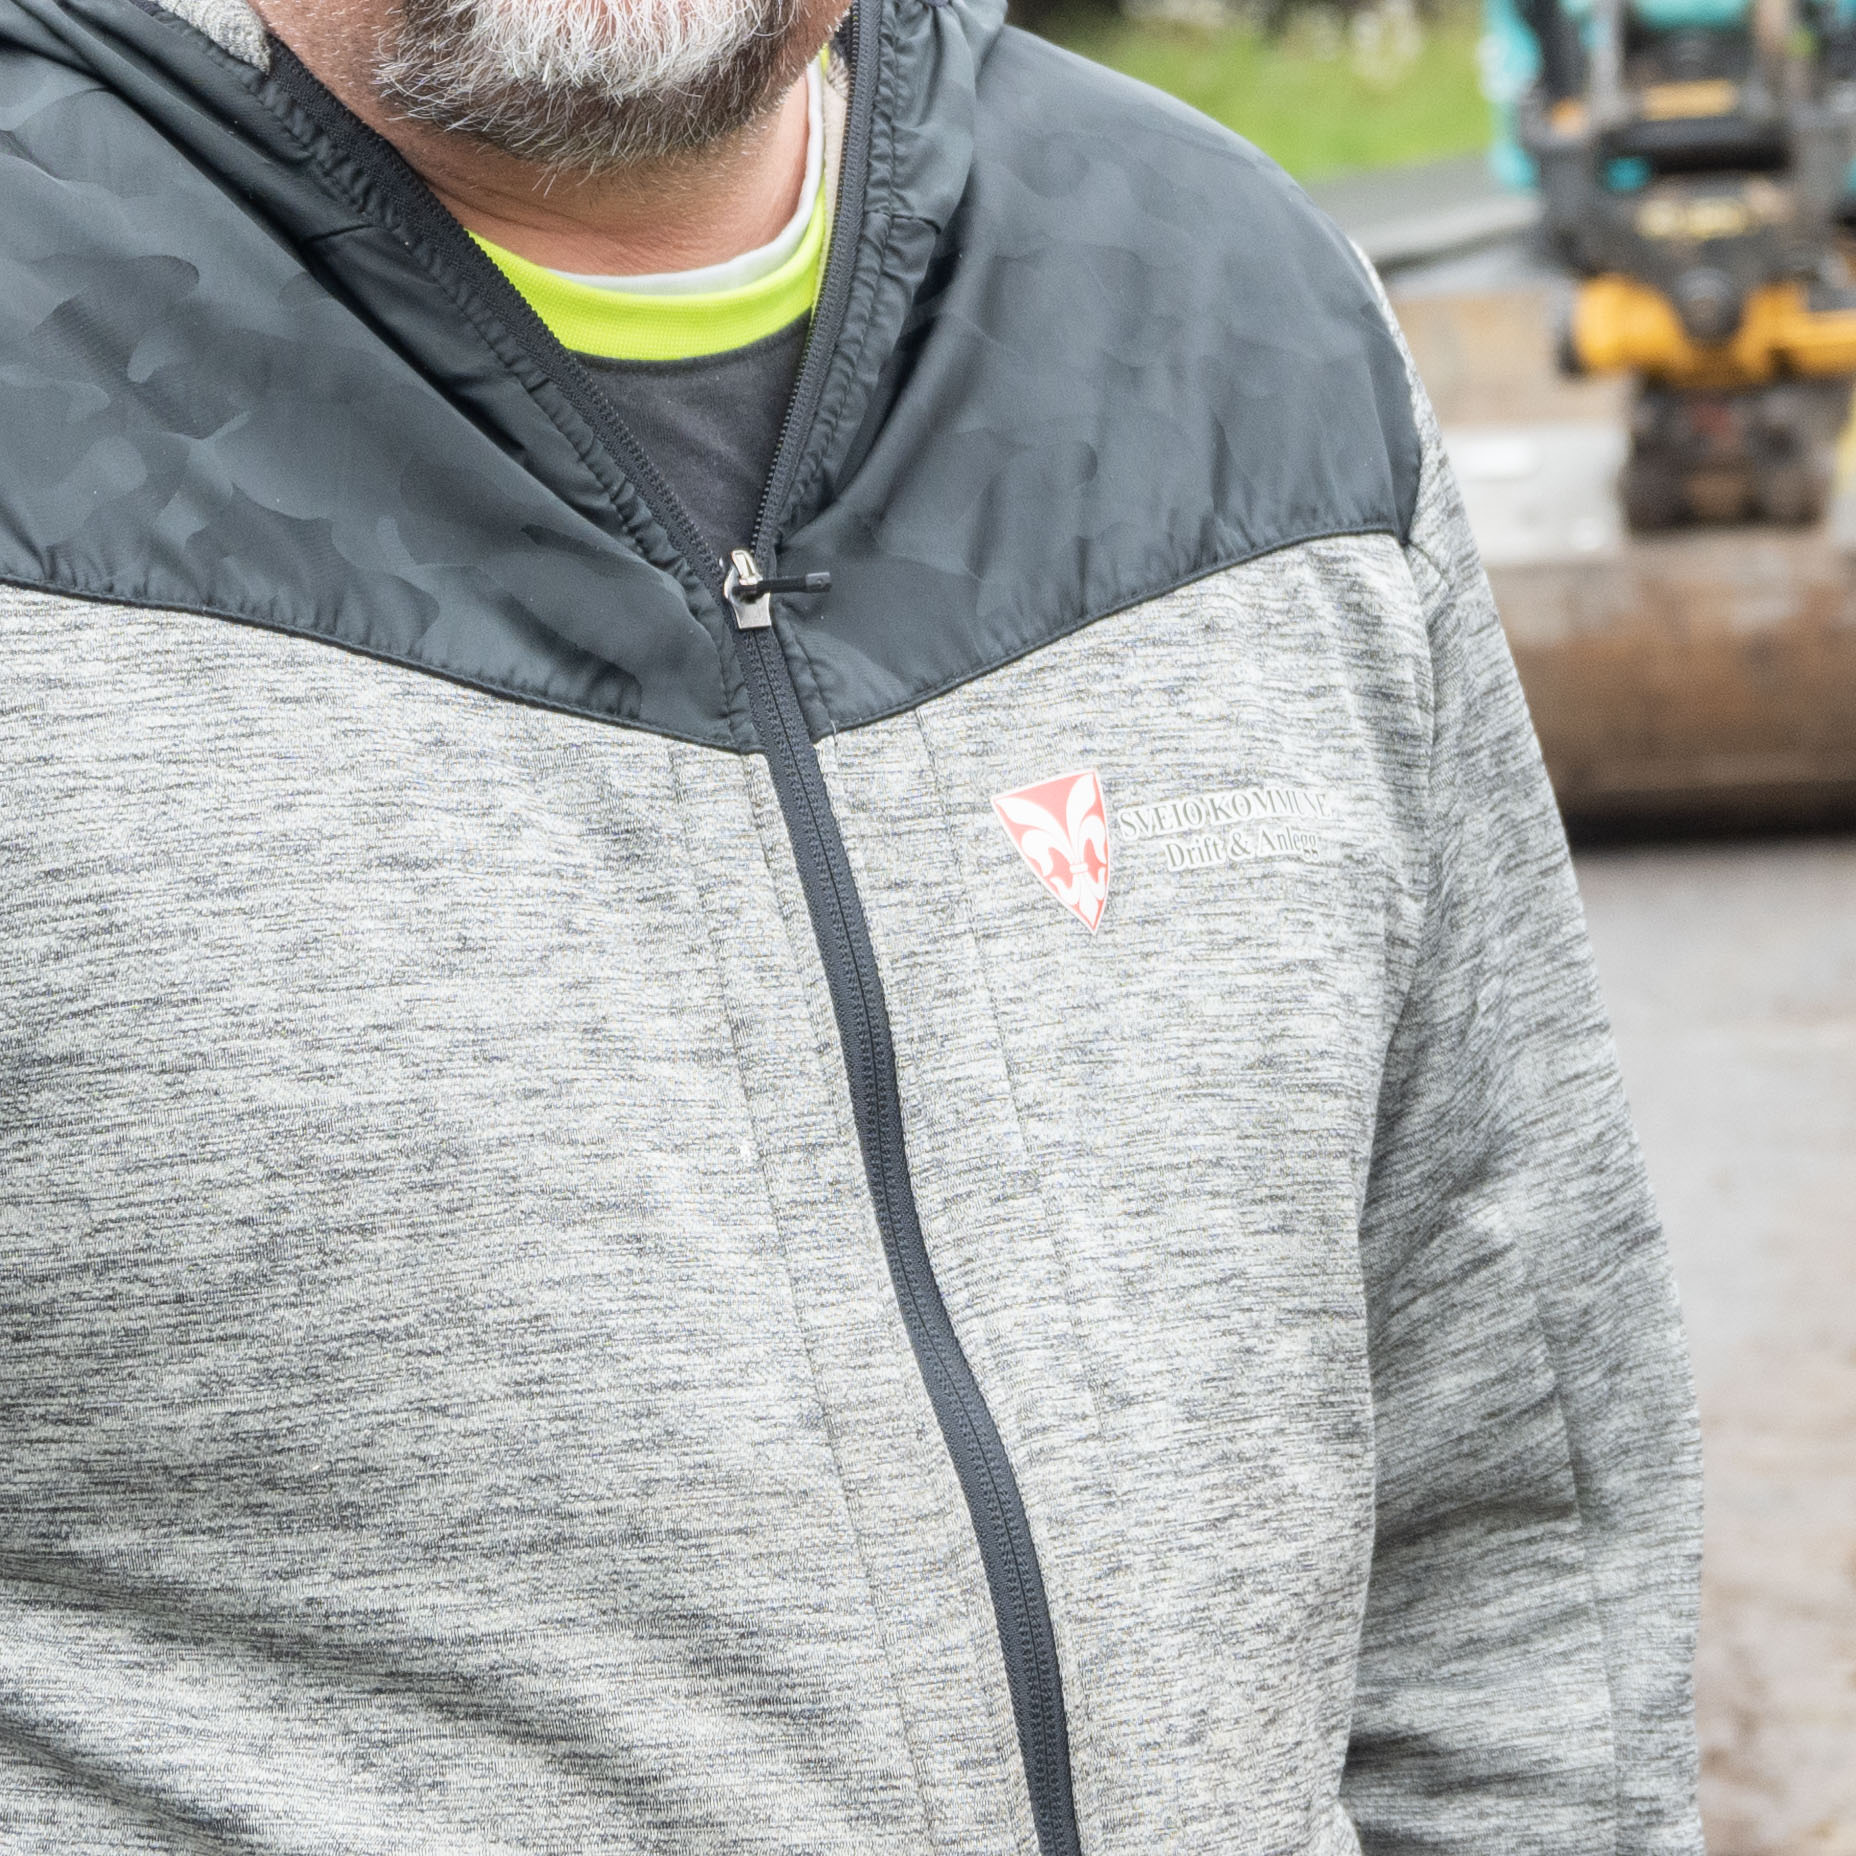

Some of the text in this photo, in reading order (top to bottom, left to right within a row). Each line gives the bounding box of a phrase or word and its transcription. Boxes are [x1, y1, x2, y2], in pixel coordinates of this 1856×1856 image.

[1119, 790, 1331, 837] SVEIO KOMMUNE
[1166, 826, 1319, 868] Drift & Anlegg
